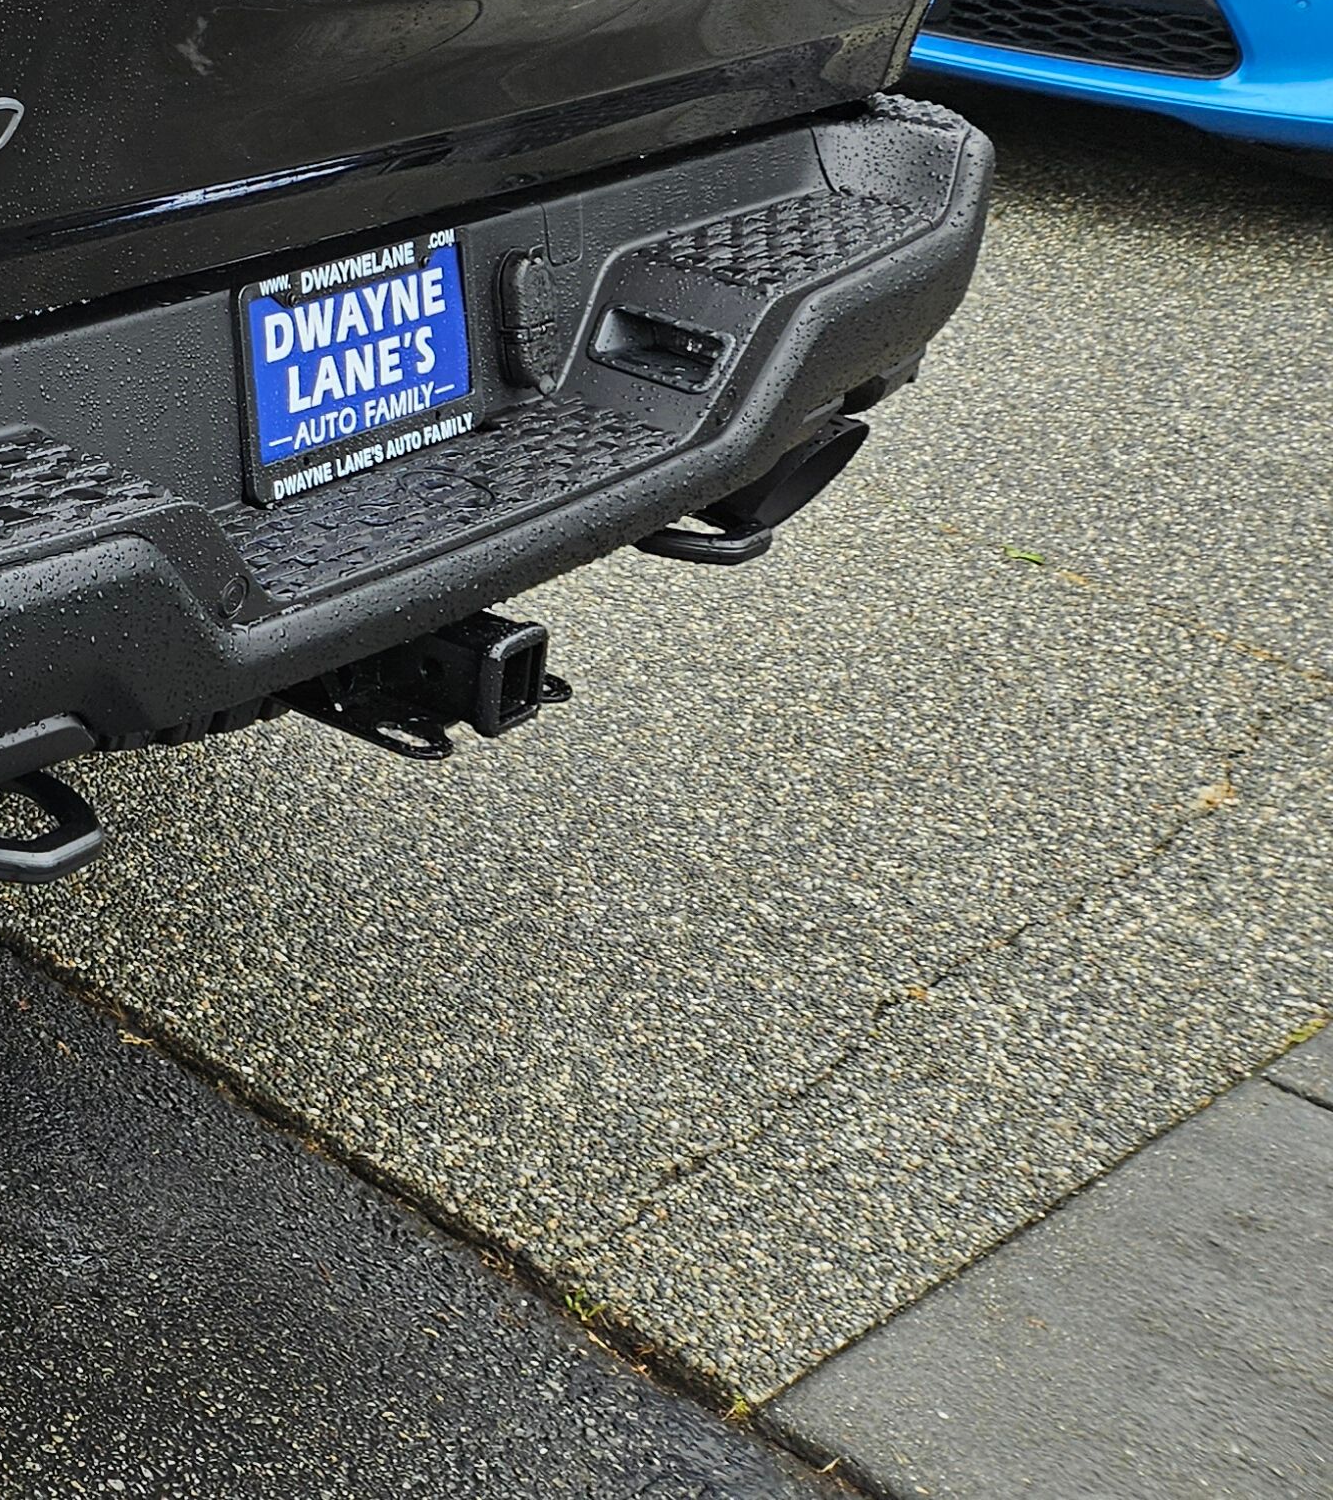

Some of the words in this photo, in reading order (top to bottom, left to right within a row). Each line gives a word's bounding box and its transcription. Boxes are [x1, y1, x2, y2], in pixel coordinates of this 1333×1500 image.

[300, 241, 415, 295] DWAYNELANE
[427, 228, 455, 250] .COM
[264, 267, 446, 363] DWAYNE
[288, 326, 436, 414] LANE'S
[273, 462, 334, 500] DWAYNE
[336, 444, 384, 478] LANE'S
[386, 430, 422, 460] AUTO
[423, 411, 474, 447] FAMILY
[293, 406, 357, 450] AUTO
[364, 381, 435, 429] FAMILY
